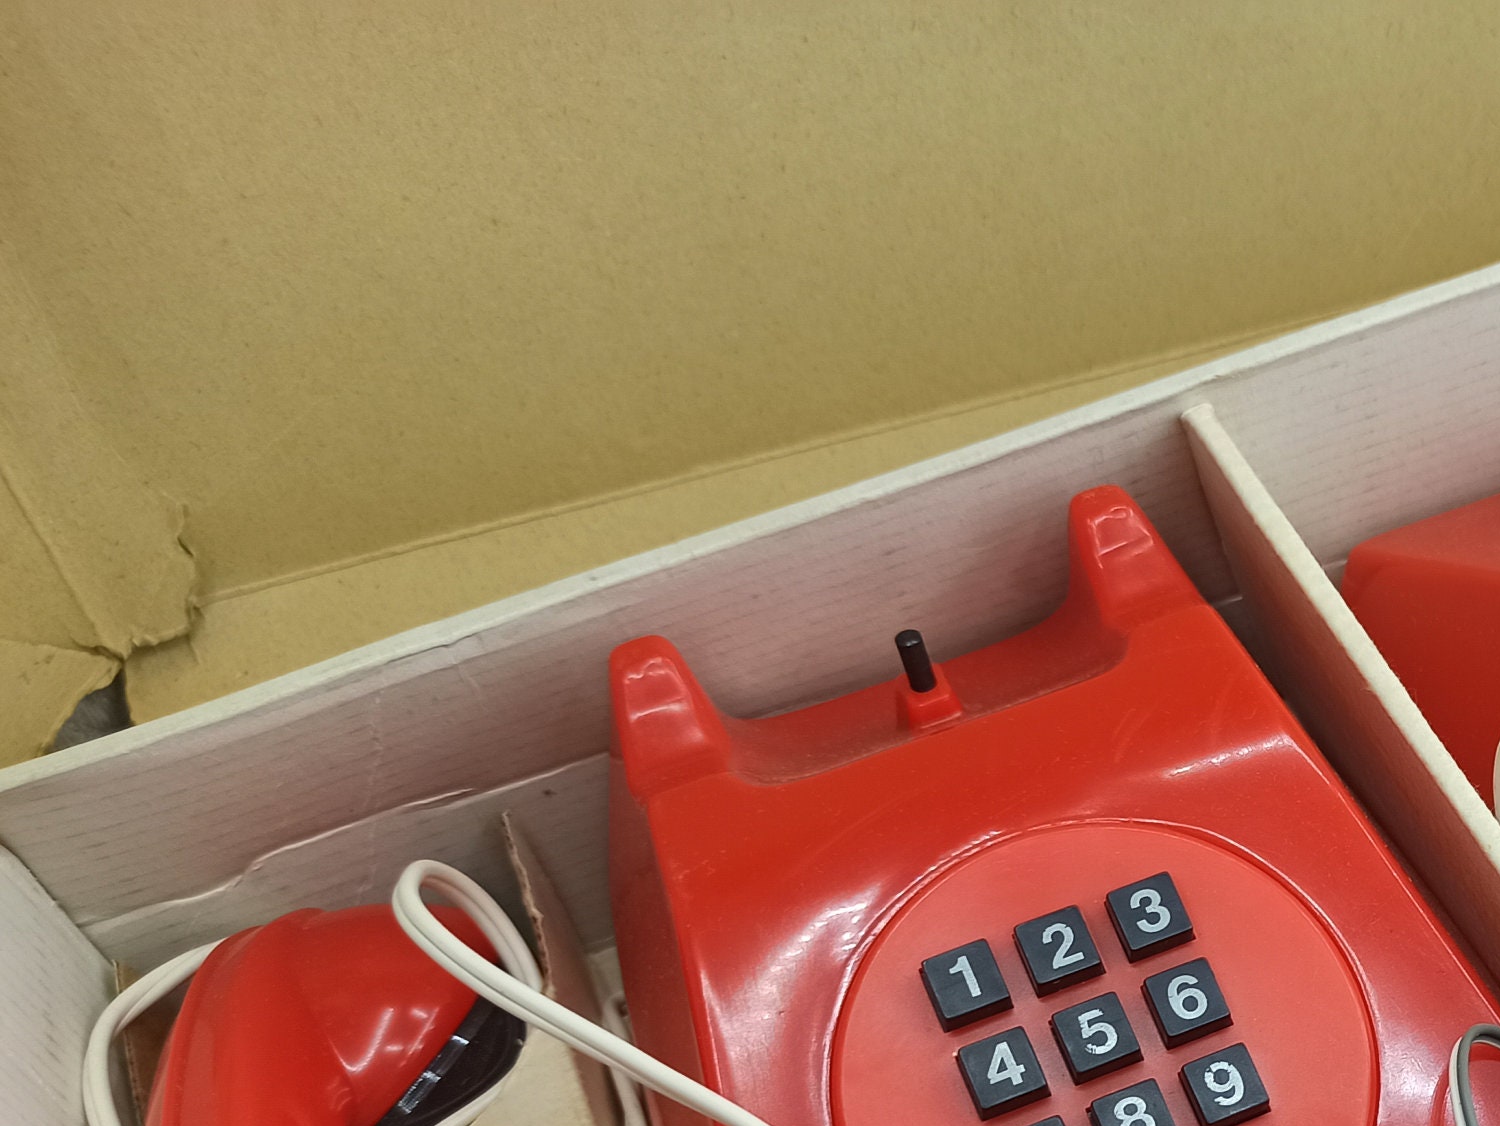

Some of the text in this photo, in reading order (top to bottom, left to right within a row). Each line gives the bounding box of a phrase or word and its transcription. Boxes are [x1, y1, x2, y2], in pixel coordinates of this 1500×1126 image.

[1130, 889, 1172, 933] 3
[1042, 923, 1085, 970] 2
[949, 956, 981, 998] 1
[1167, 975, 1208, 1020] 6
[1077, 1009, 1119, 1055] 5
[987, 1041, 1025, 1086] 4
[1204, 1061, 1245, 1106] 9
